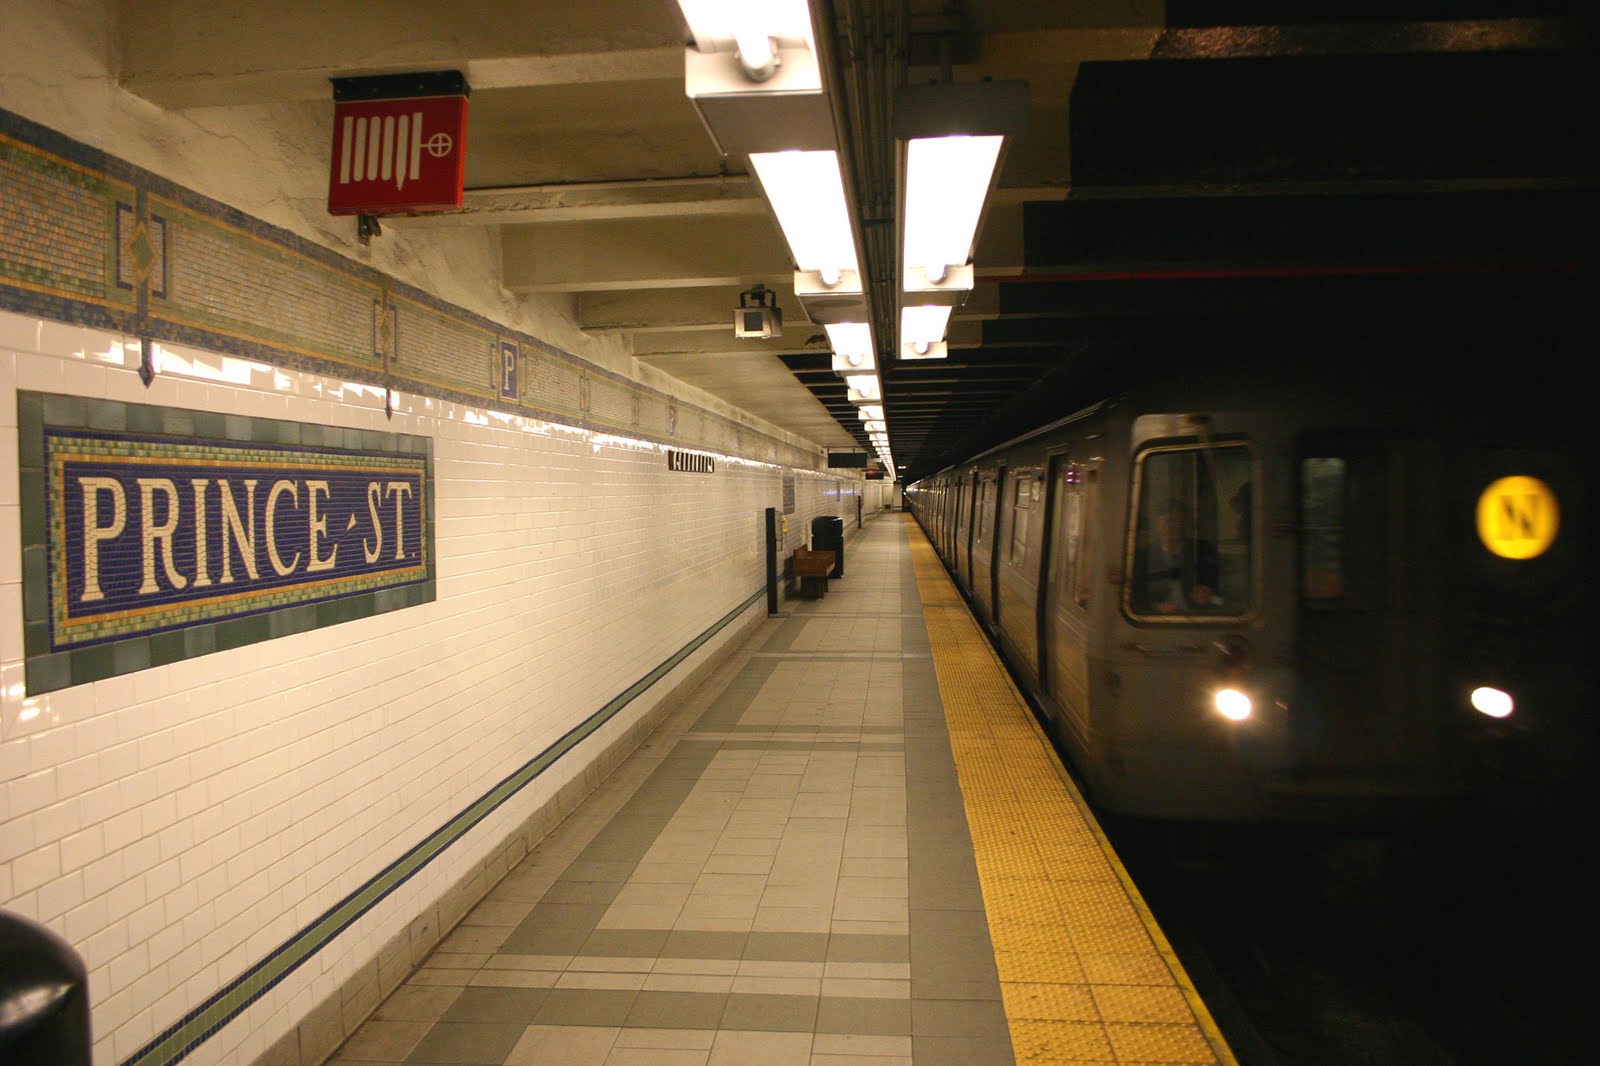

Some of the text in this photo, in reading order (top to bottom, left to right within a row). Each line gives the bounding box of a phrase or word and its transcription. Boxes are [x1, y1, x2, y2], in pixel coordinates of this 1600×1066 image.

[503, 350, 514, 391] P
[78, 476, 338, 602] PRINCE
[1496, 494, 1541, 540] N
